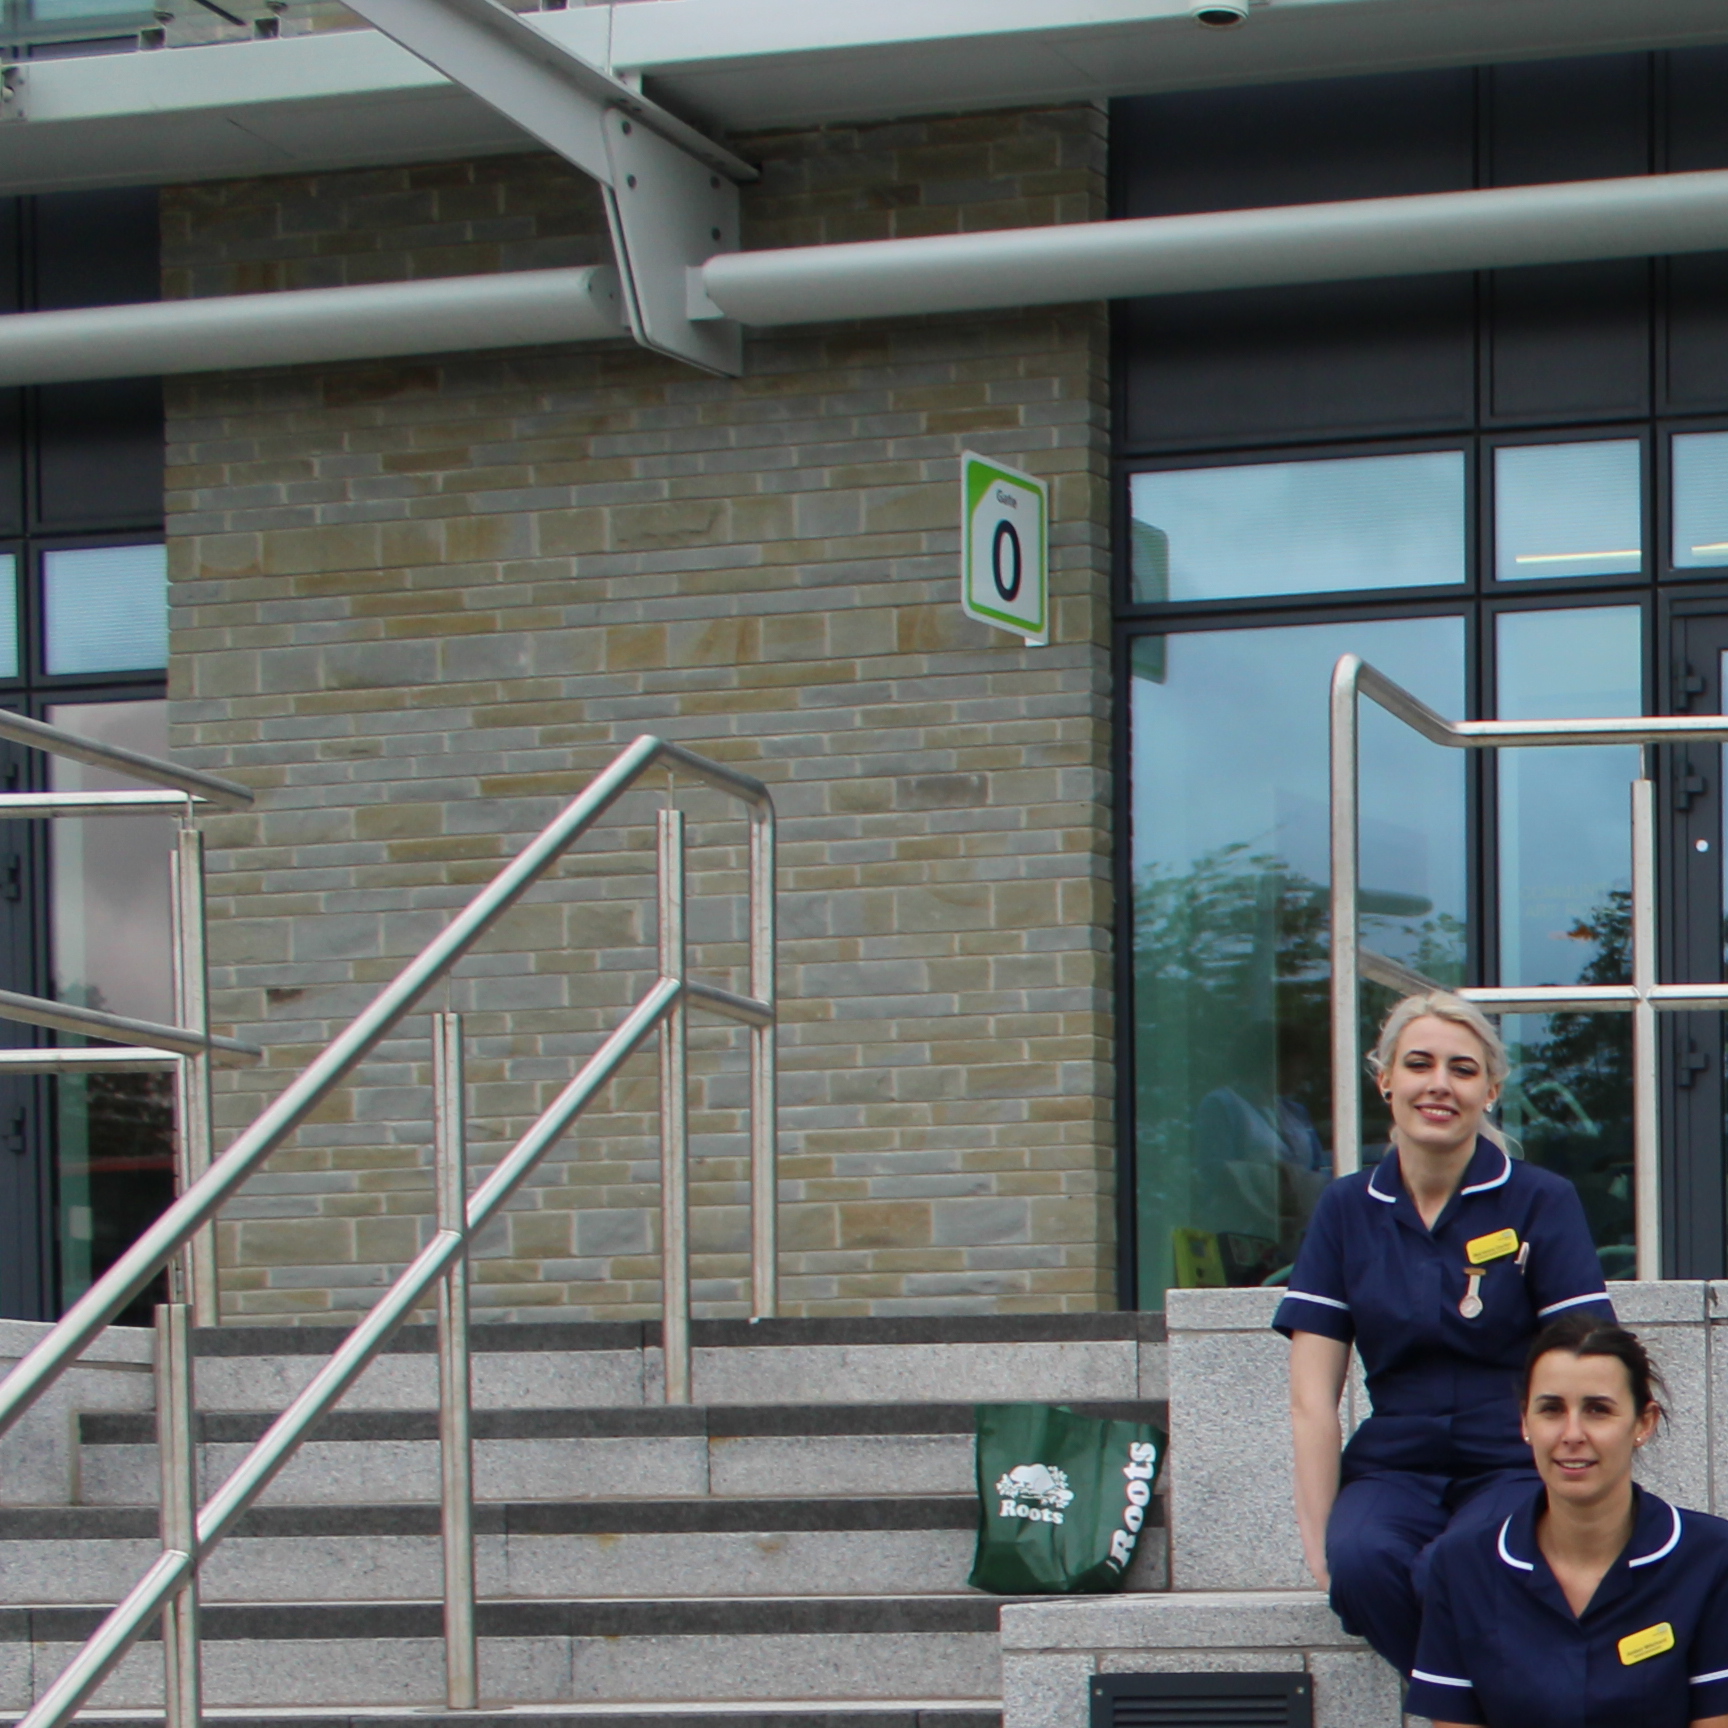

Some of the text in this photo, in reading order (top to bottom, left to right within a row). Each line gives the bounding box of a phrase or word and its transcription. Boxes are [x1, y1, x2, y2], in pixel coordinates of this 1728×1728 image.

[992, 519, 1021, 602] 0
[1000, 1499, 1064, 1525] Roots
[1110, 1441, 1157, 1568] Roots
